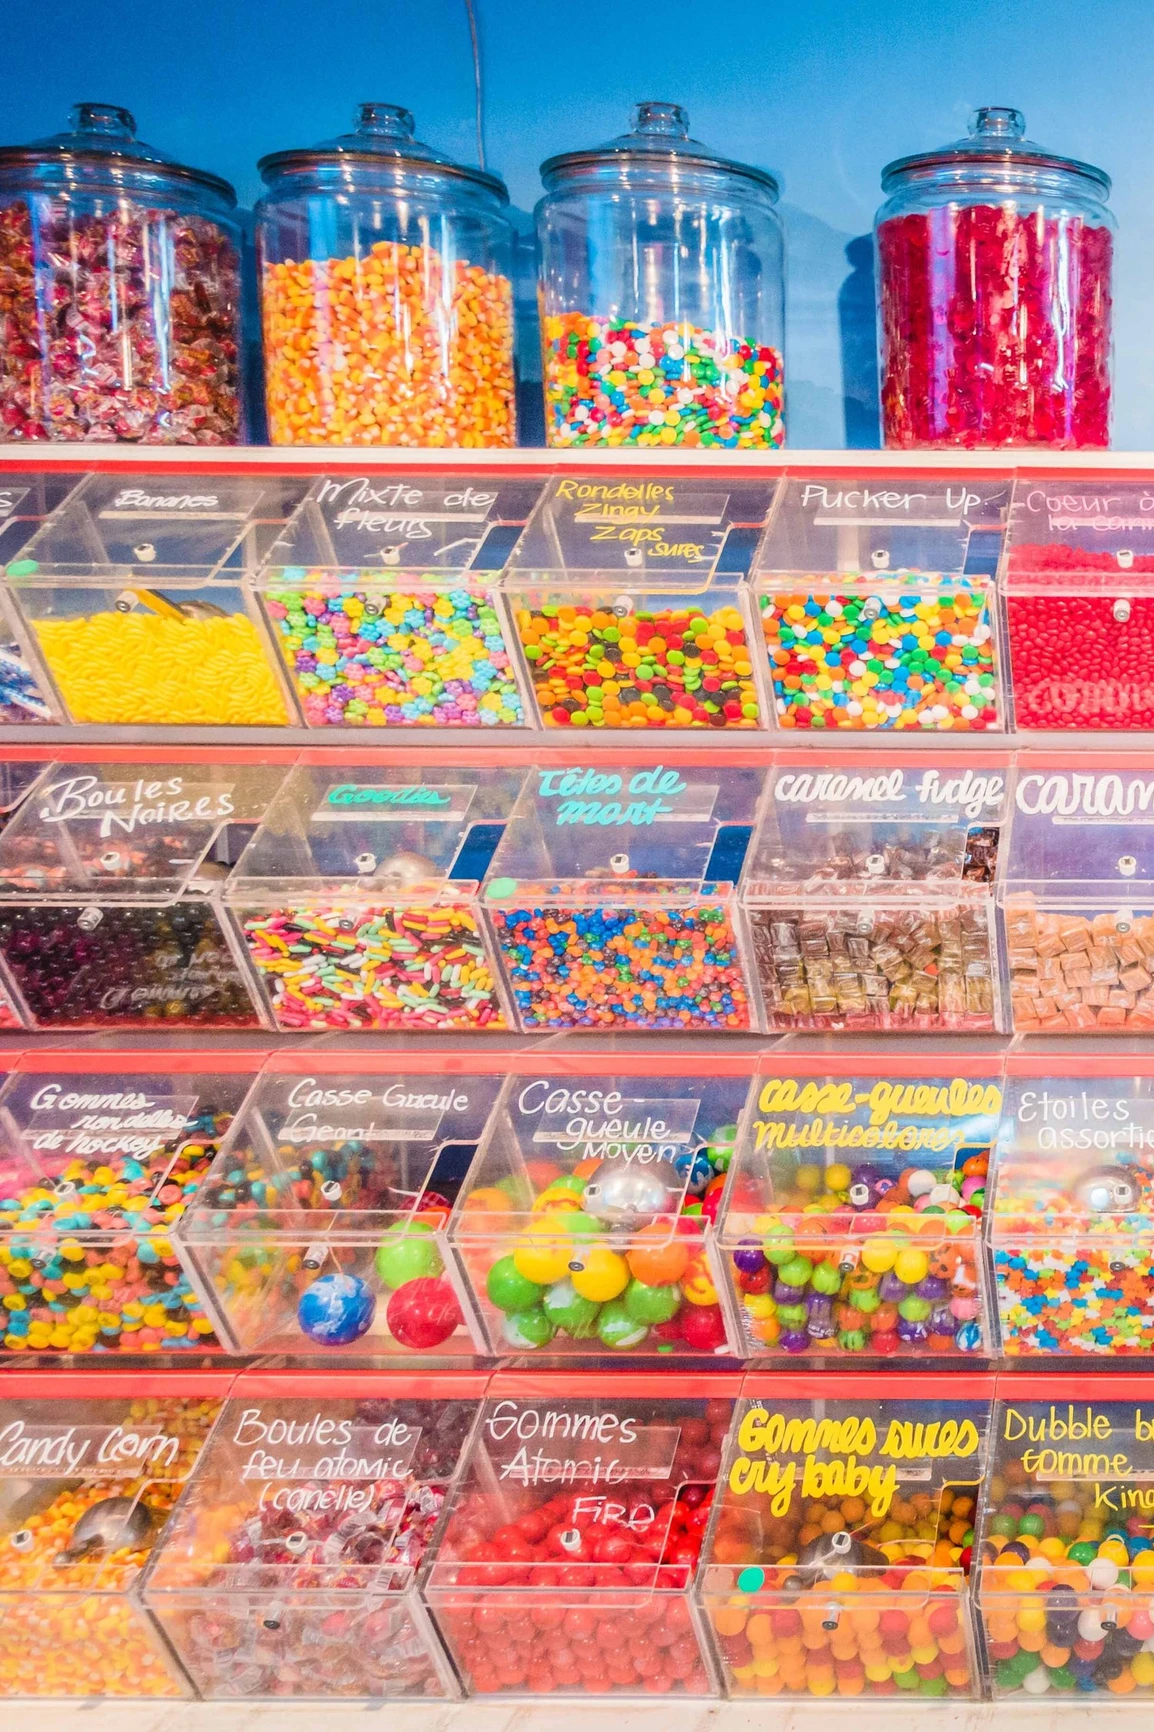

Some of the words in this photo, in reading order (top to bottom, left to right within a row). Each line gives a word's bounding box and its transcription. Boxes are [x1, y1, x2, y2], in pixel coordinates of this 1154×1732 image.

[114, 489, 218, 510] Bananes
[315, 477, 424, 505] Mixte
[444, 487, 495, 508] de
[555, 479, 675, 501] Rondelles
[800, 484, 927, 508] Pucker
[946, 487, 981, 515] Up
[1026, 489, 1120, 513] Coeur
[333, 506, 433, 539] fleurs
[574, 503, 661, 525] Zingy
[590, 525, 666, 547] Zaps
[628, 765, 687, 795] de
[774, 768, 908, 803] caramel
[915, 769, 1005, 819] fudge
[40, 775, 183, 823] Boules
[556, 797, 673, 826] mort
[287, 1078, 373, 1109] Casse
[1017, 1091, 1130, 1122] Etoiles
[33, 1130, 62, 1150] de
[65, 1132, 166, 1160] hockey
[556, 1116, 671, 1151] gueule
[581, 1142, 677, 1170] Moyen
[232, 1408, 353, 1447] Boules
[374, 1416, 412, 1446] de
[484, 1399, 638, 1444] Gommes
[738, 1407, 878, 1456] Gommes
[1003, 1404, 1113, 1441] Dubble
[0, 1419, 92, 1476] Candy
[97, 1425, 181, 1467] Corn
[240, 1448, 301, 1480] feu
[313, 1446, 415, 1479] atomic
[728, 1456, 797, 1518] cry
[801, 1453, 901, 1518] baby
